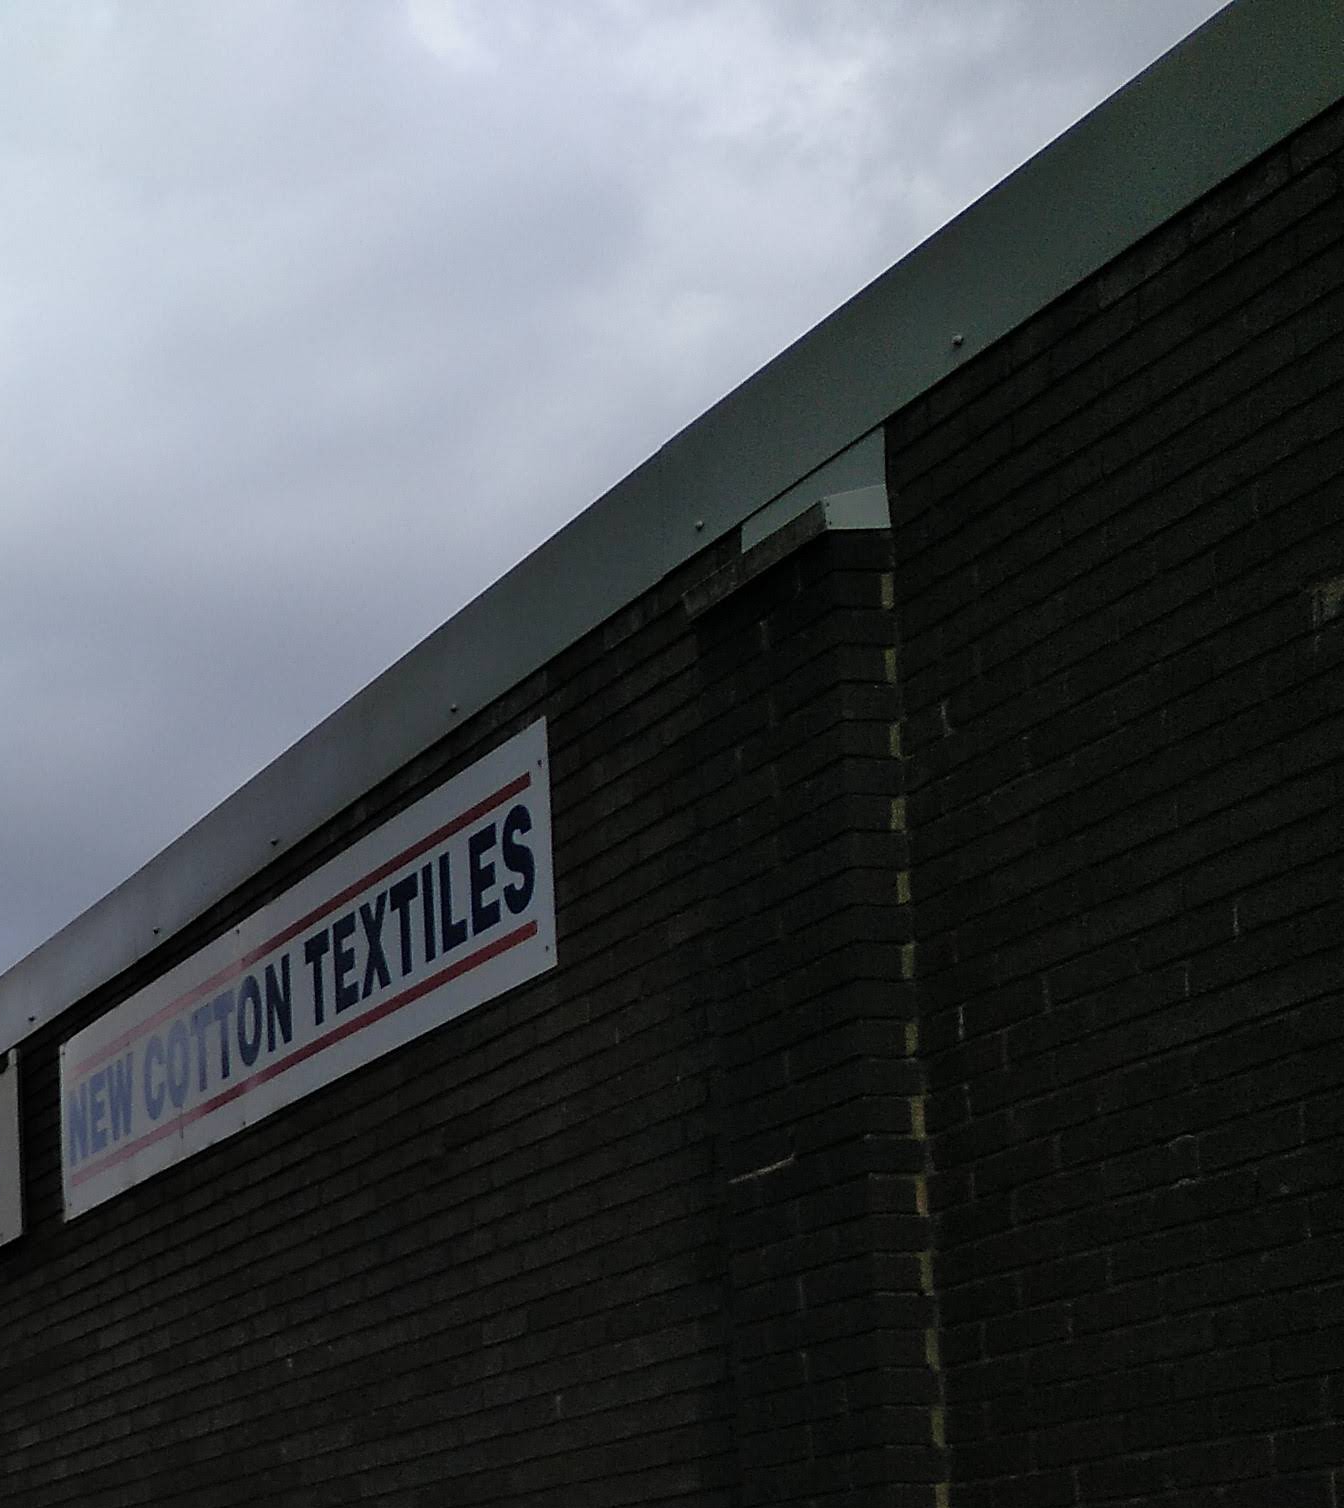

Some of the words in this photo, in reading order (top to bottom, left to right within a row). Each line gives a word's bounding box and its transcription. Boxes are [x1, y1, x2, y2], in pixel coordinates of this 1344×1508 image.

[68, 1052, 133, 1168] NEW
[142, 952, 294, 1121] COTTON
[304, 803, 535, 1026] TEXTILES
